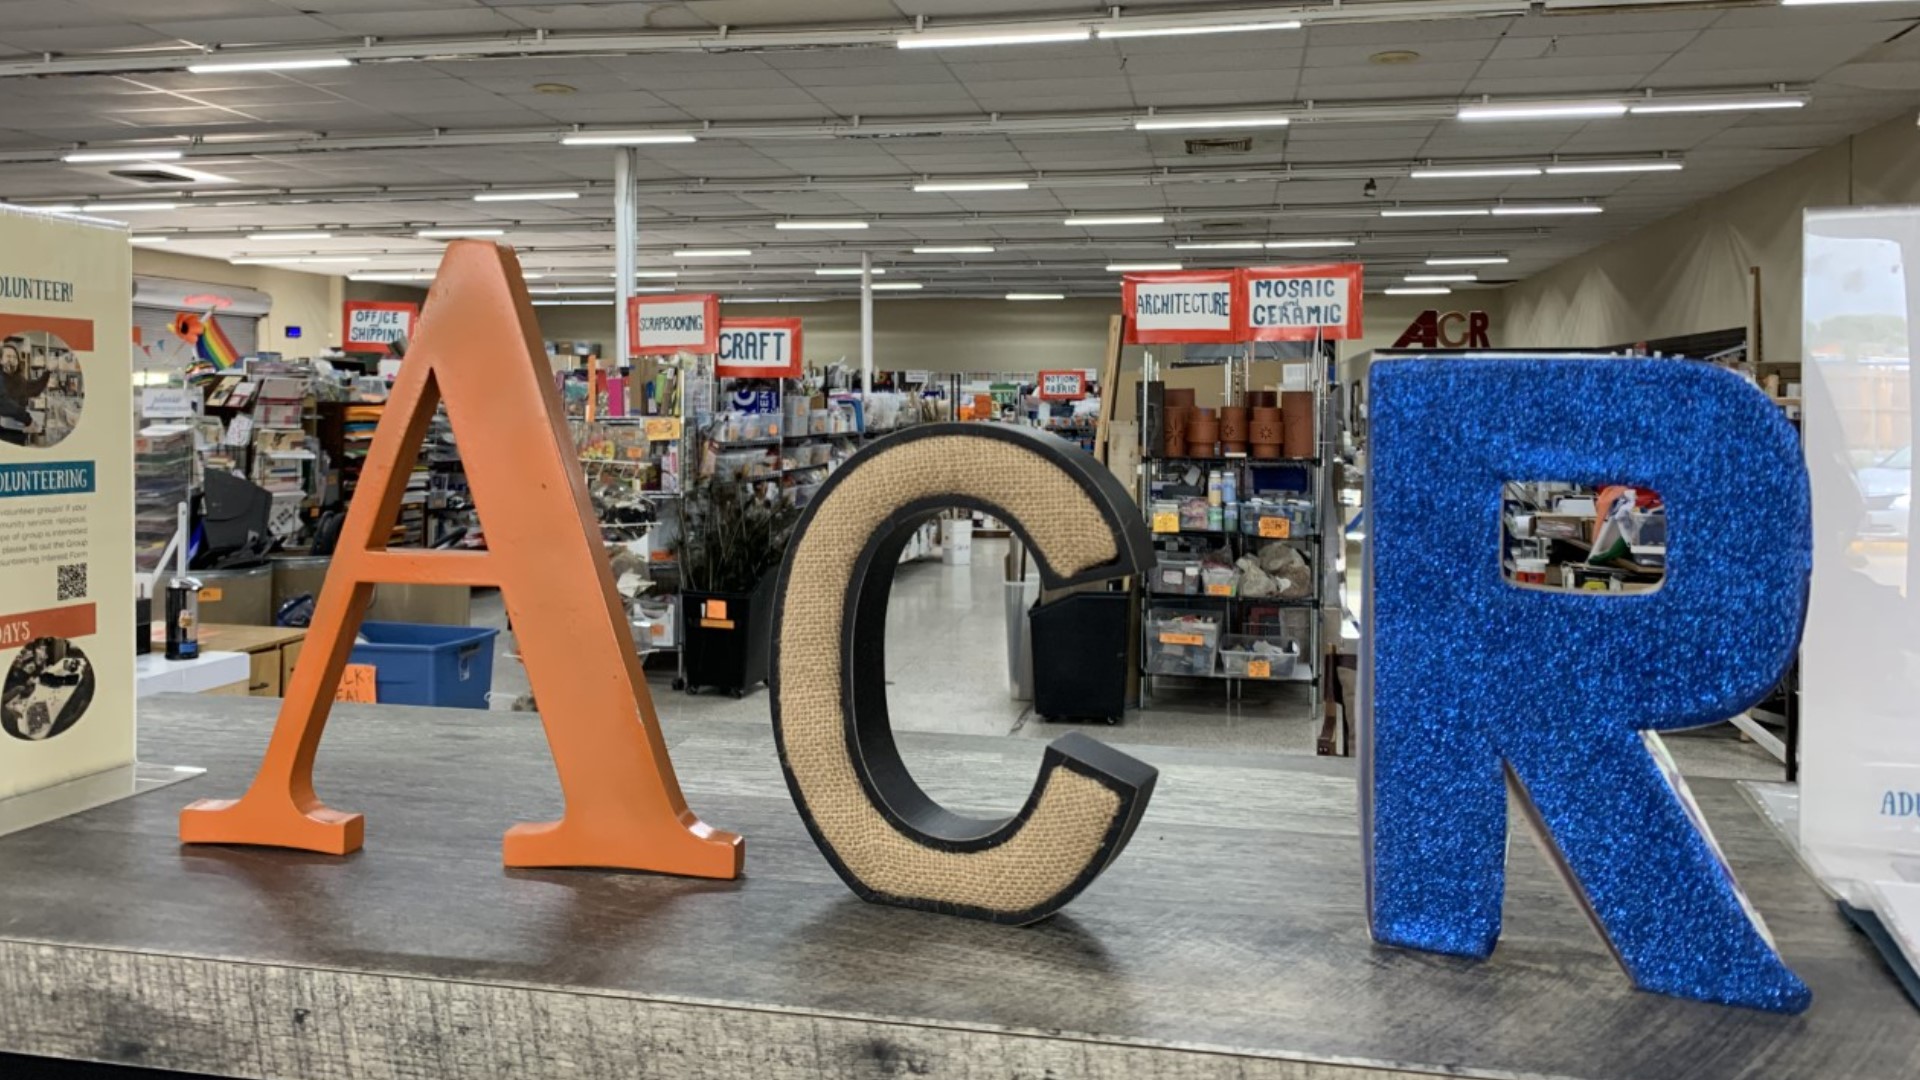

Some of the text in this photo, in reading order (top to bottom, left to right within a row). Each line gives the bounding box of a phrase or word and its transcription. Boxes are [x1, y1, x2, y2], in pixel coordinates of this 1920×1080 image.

[1255, 279, 1335, 298] MOSAIC
[1137, 292, 1230, 317] ARCHITECTURE
[1253, 304, 1342, 325] CERAMIC
[355, 311, 399, 325] OFFICE
[639, 315, 703, 332] SCRAPBOOKING
[1391, 310, 1491, 348] ACR
[718, 332, 785, 361] CRAFT
[1046, 385, 1077, 394] FABRIC
[0, 621, 31, 643] AYS
